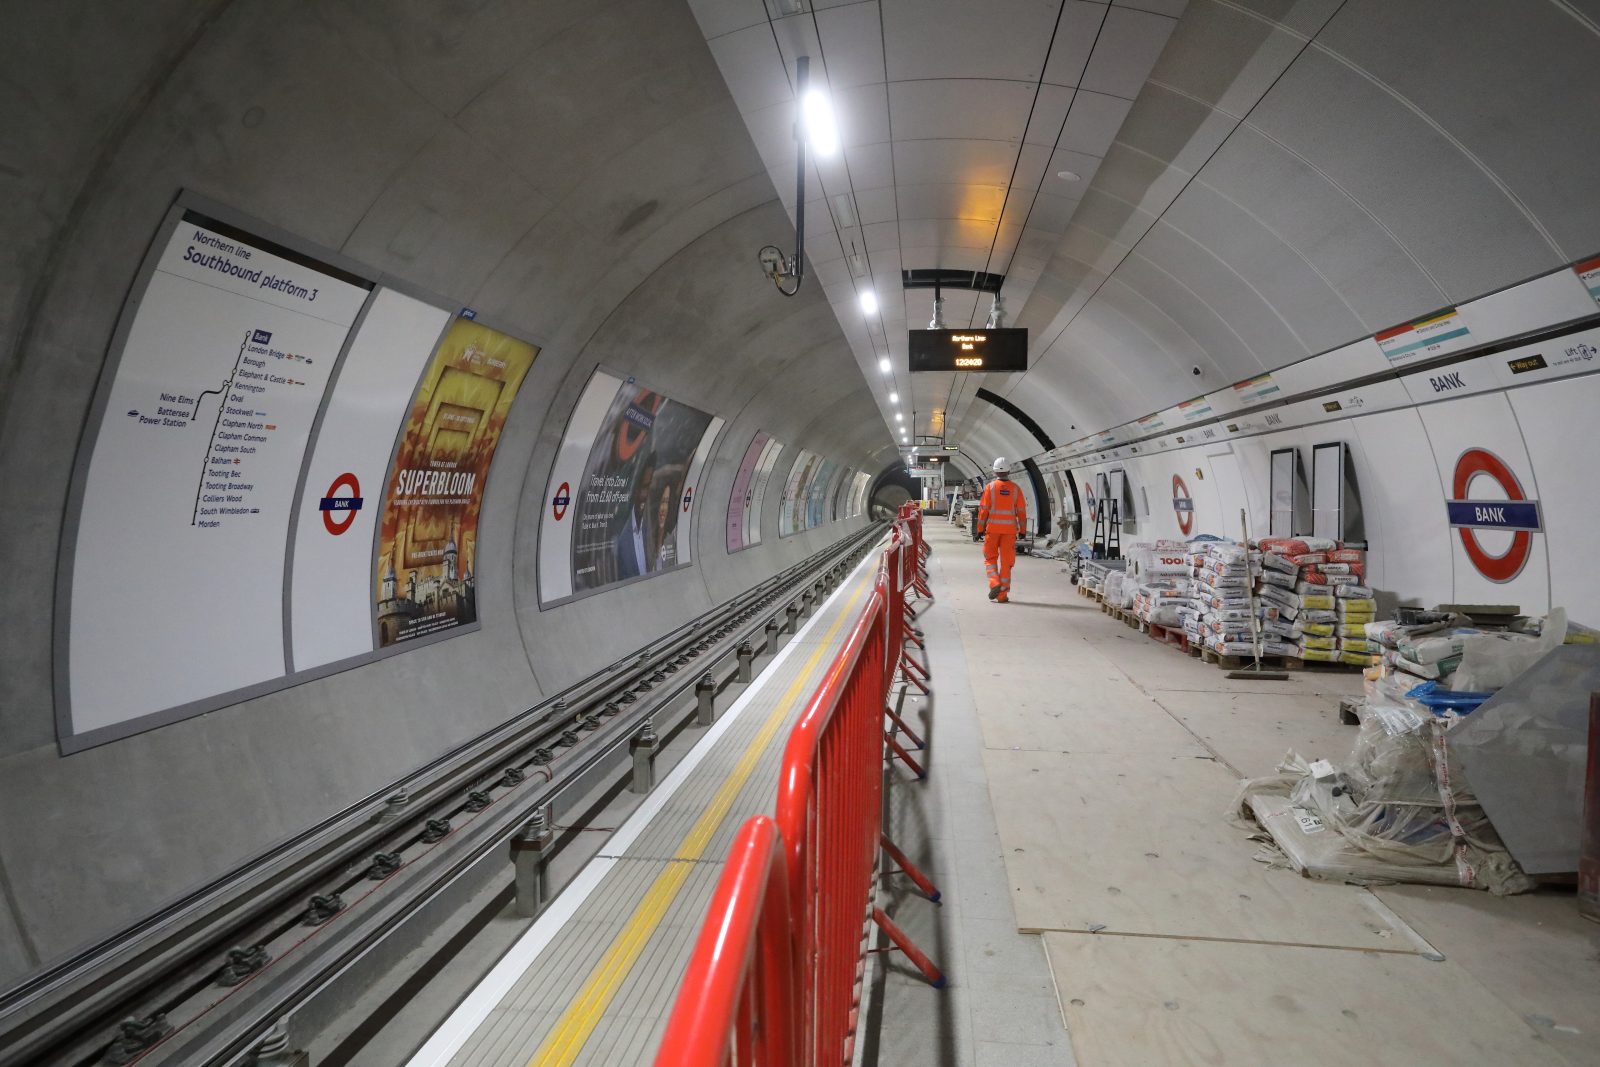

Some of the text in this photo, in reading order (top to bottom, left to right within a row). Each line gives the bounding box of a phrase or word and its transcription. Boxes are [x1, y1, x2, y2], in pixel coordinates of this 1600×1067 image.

[193, 230, 251, 260] Northern line
[183, 246, 318, 301] Southbound platform 3
[255, 332, 268, 343] Bank
[247, 345, 285, 360] London Bridge
[1564, 347, 1579, 357] Lift
[243, 357, 266, 368] Borough
[1515, 358, 1538, 371] Way out
[239, 369, 262, 381] Elephant
[270, 375, 286, 384] Castle
[1430, 371, 1466, 393] BANK
[235, 382, 266, 394] Kennington
[160, 393, 194, 405] Nine Elms
[230, 394, 244, 403] Oval
[157, 407, 189, 418] Battersea
[226, 407, 254, 417] Stockwell
[139, 415, 187, 428] Power Station
[222, 418, 264, 430] Clapham North
[218, 431, 267, 442] Clapham Common
[214, 444, 256, 454] Clapham South
[211, 457, 232, 465] Balham
[208, 470, 229, 478] Tooting
[205, 482, 253, 491] Tooting Broadway
[396, 469, 476, 496] SUPERBLOOM
[586, 491, 599, 503] from
[334, 500, 351, 508] BANK
[1475, 507, 1506, 523] BANK
